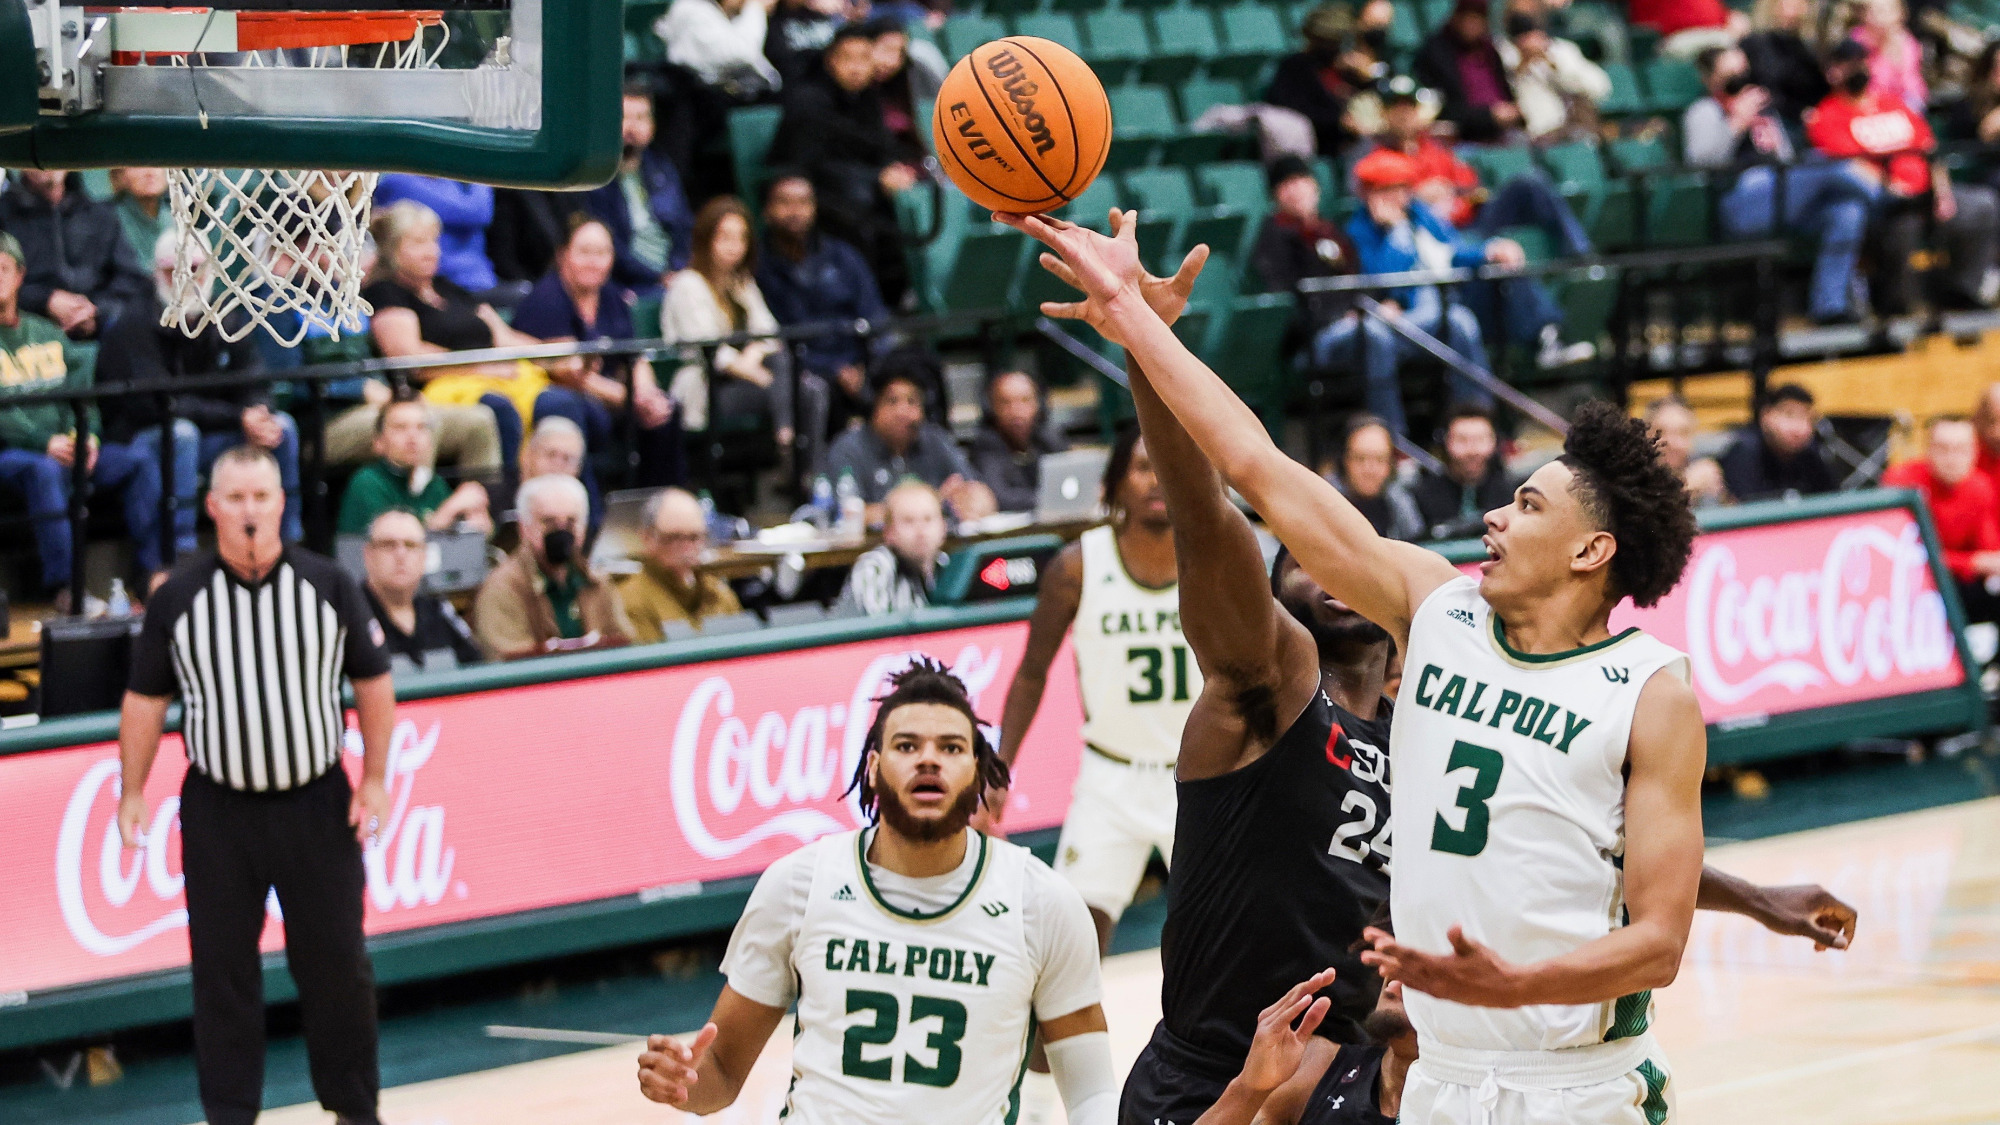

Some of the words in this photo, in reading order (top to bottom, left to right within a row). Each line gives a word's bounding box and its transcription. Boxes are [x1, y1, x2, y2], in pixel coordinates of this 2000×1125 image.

[987, 49, 1055, 160] Wilson
[1100, 610, 1148, 635] CAL
[1446, 609, 1476, 629] adidas
[1127, 646, 1189, 703] 31
[1415, 663, 1488, 722] CAL
[1488, 689, 1593, 755] POLY
[1430, 739, 1504, 857] 3
[826, 938, 897, 974] CAL
[904, 945, 996, 986] POLY
[842, 988, 968, 1088] 23
